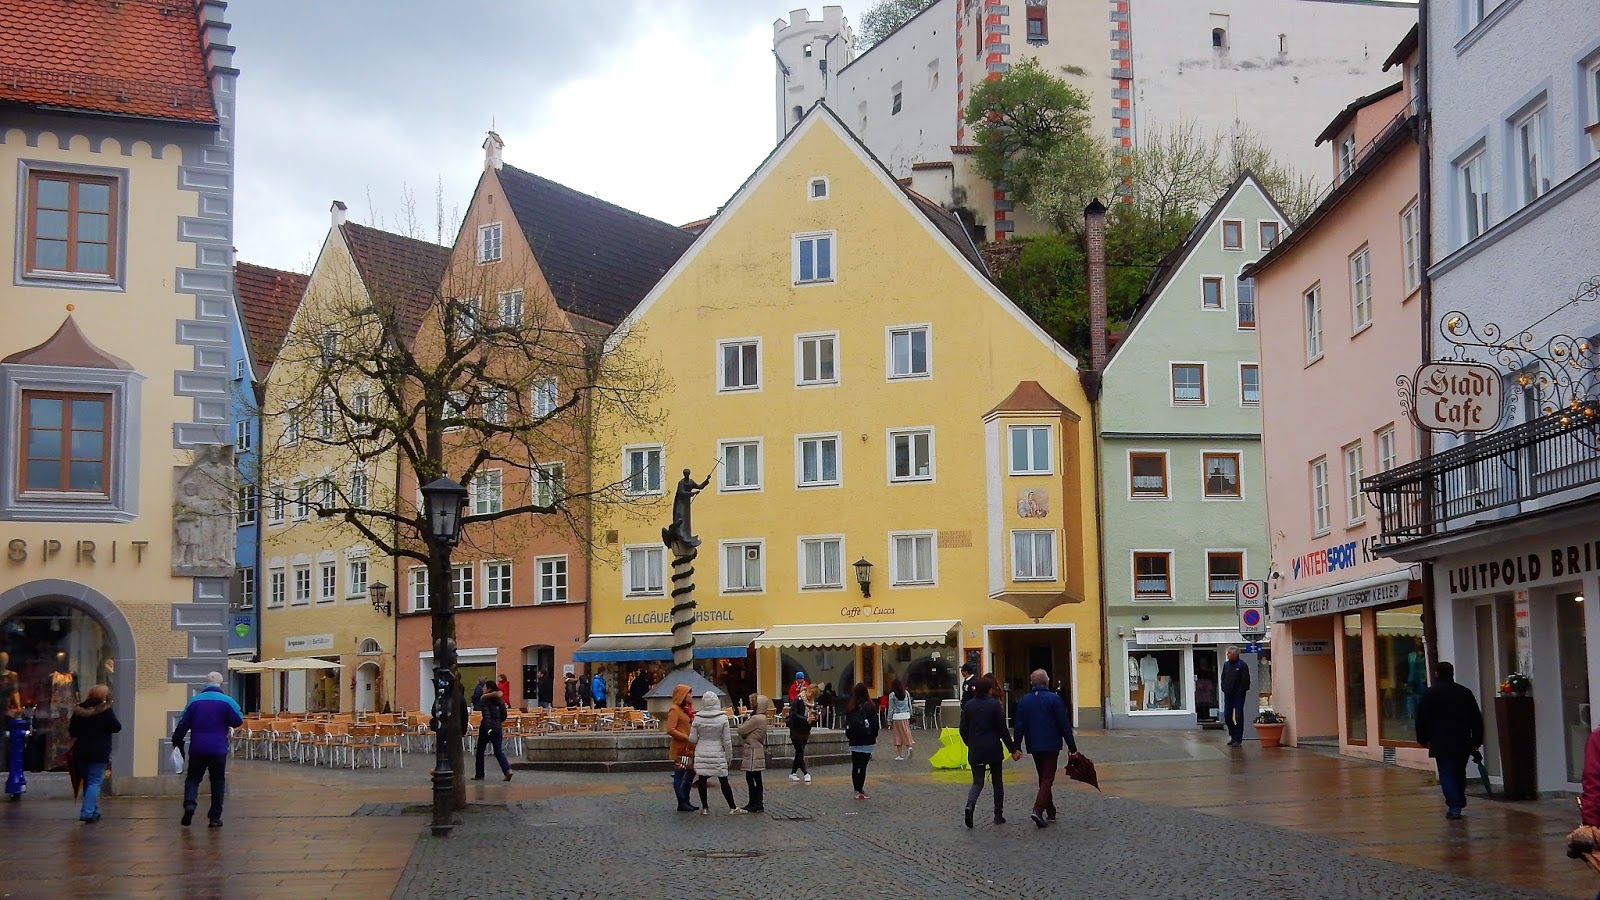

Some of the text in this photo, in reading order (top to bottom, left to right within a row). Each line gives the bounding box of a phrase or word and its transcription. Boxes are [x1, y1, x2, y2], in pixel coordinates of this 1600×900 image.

[1420, 366, 1493, 396] Stadt
[1435, 397, 1482, 427] Cafe
[8, 539, 148, 563] SPRIT
[1300, 542, 1357, 578] INTERSPORT
[1449, 554, 1541, 594] LUITPOLD
[1246, 587, 1255, 595] 10
[1284, 584, 1399, 618] INTERSPORT KELLER INTERSPORT KELLER
[693, 610, 735, 622] HSTALL
[873, 606, 895, 615] Lucca
